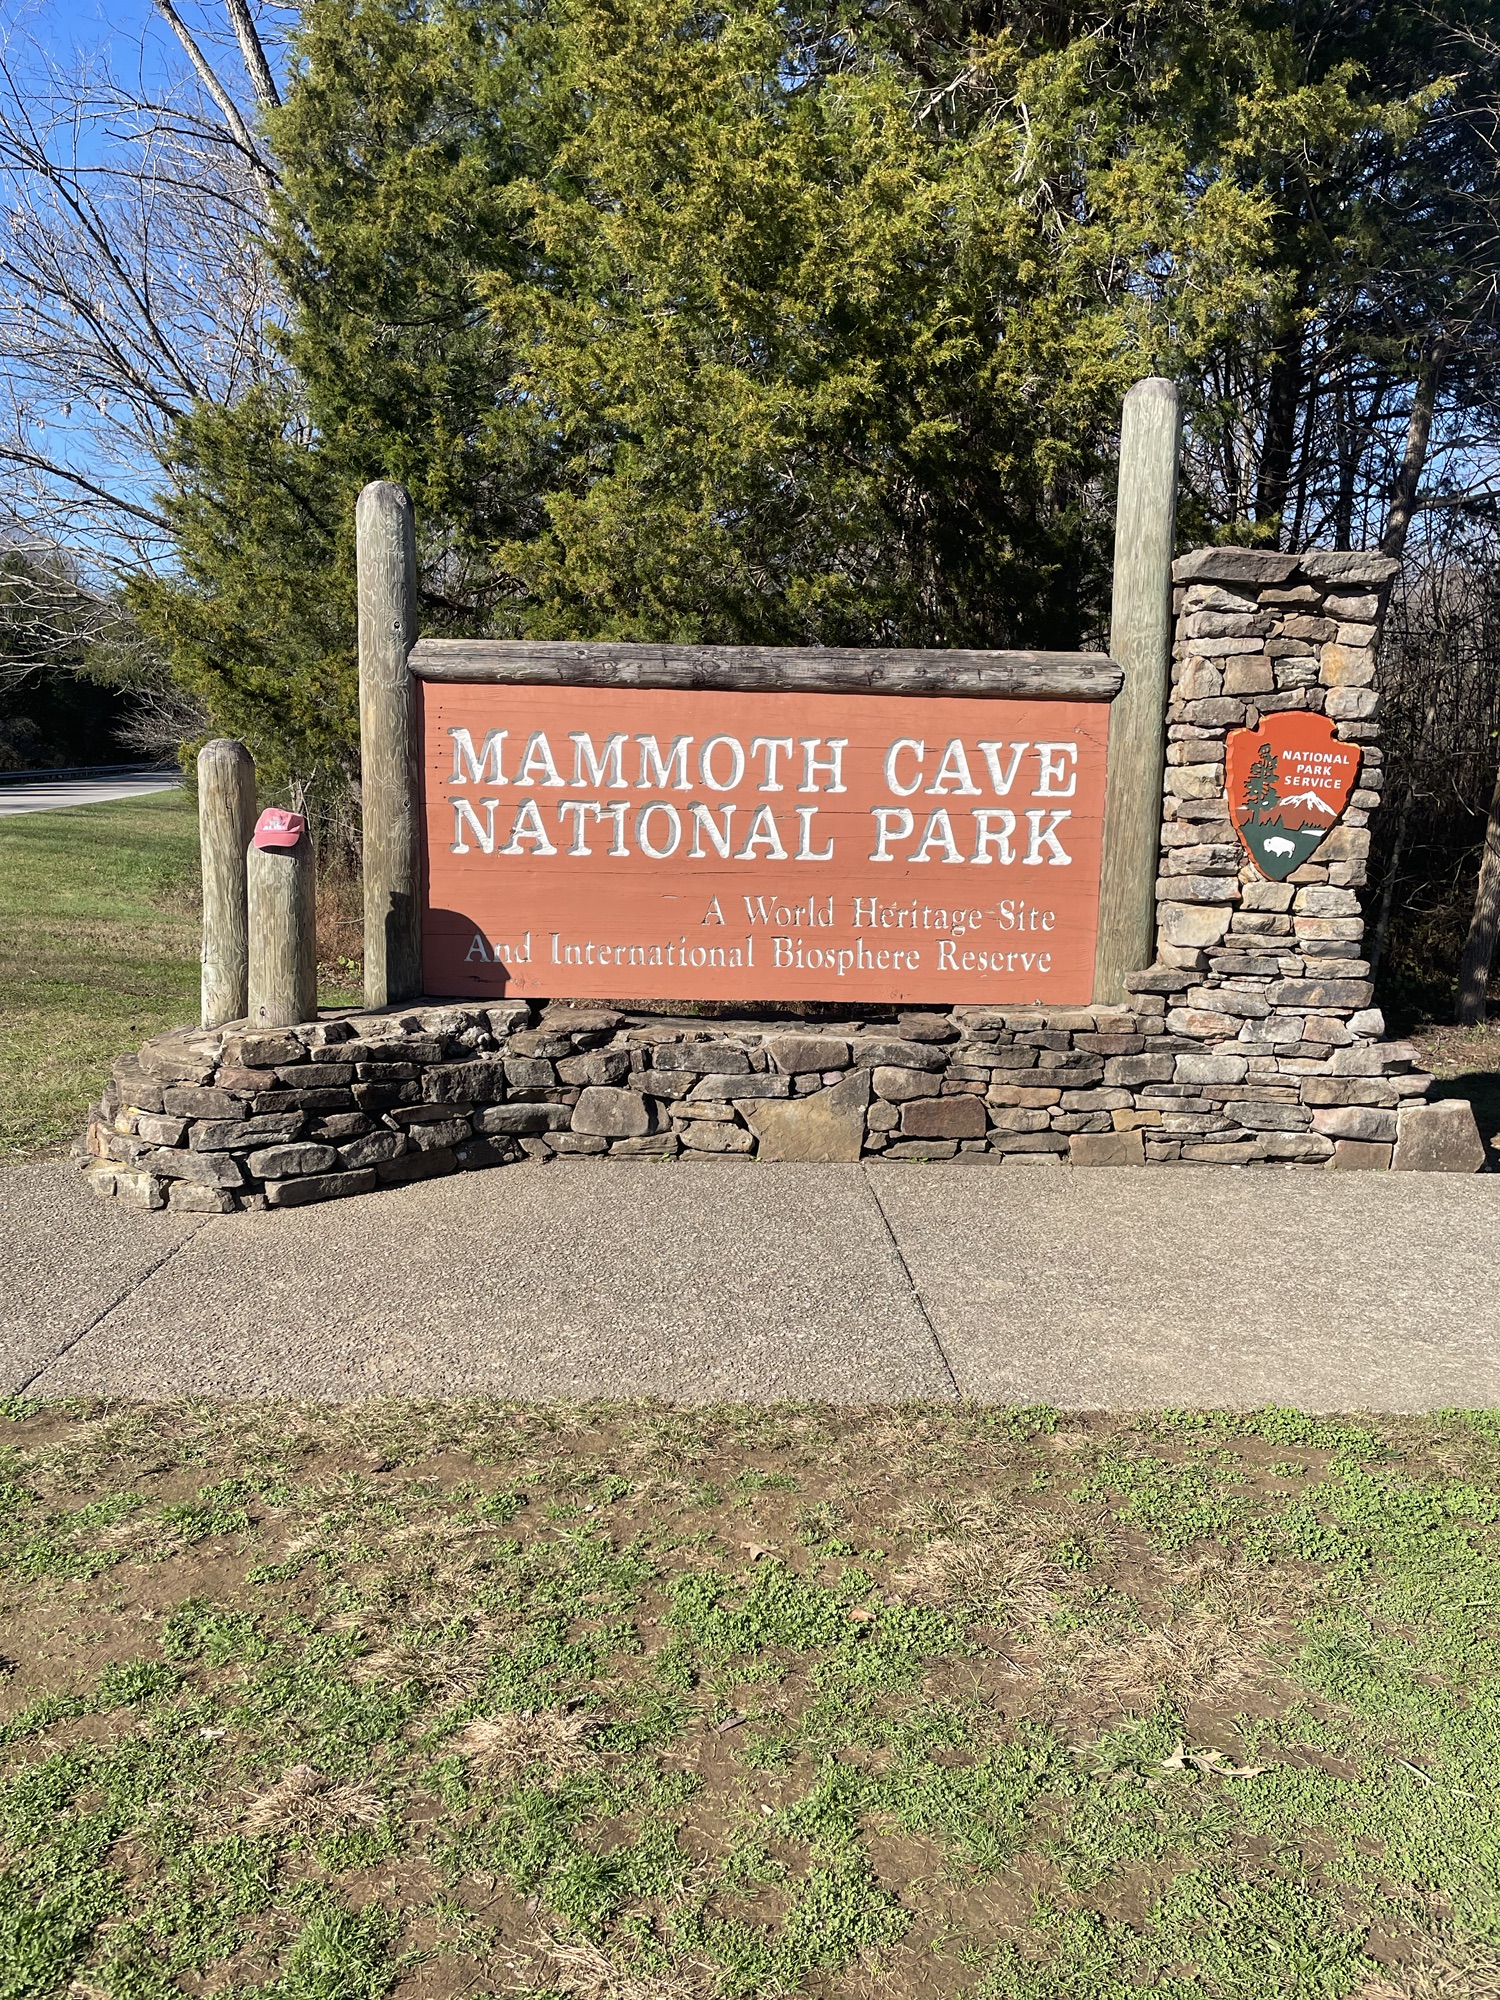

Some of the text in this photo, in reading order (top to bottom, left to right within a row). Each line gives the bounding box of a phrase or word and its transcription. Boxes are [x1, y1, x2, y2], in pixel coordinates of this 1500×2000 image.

[447, 727, 1078, 797] MAMMOTH CAVE
[1282, 750, 1350, 765] NATIONAL
[1296, 764, 1332, 776] PARK
[1284, 775, 1342, 789] SERVICE
[448, 796, 1072, 866] NATIONAL PARK
[701, 894, 1057, 937] A World Heritage Site
[464, 931, 1052, 976] And International Biosphere Reserve
